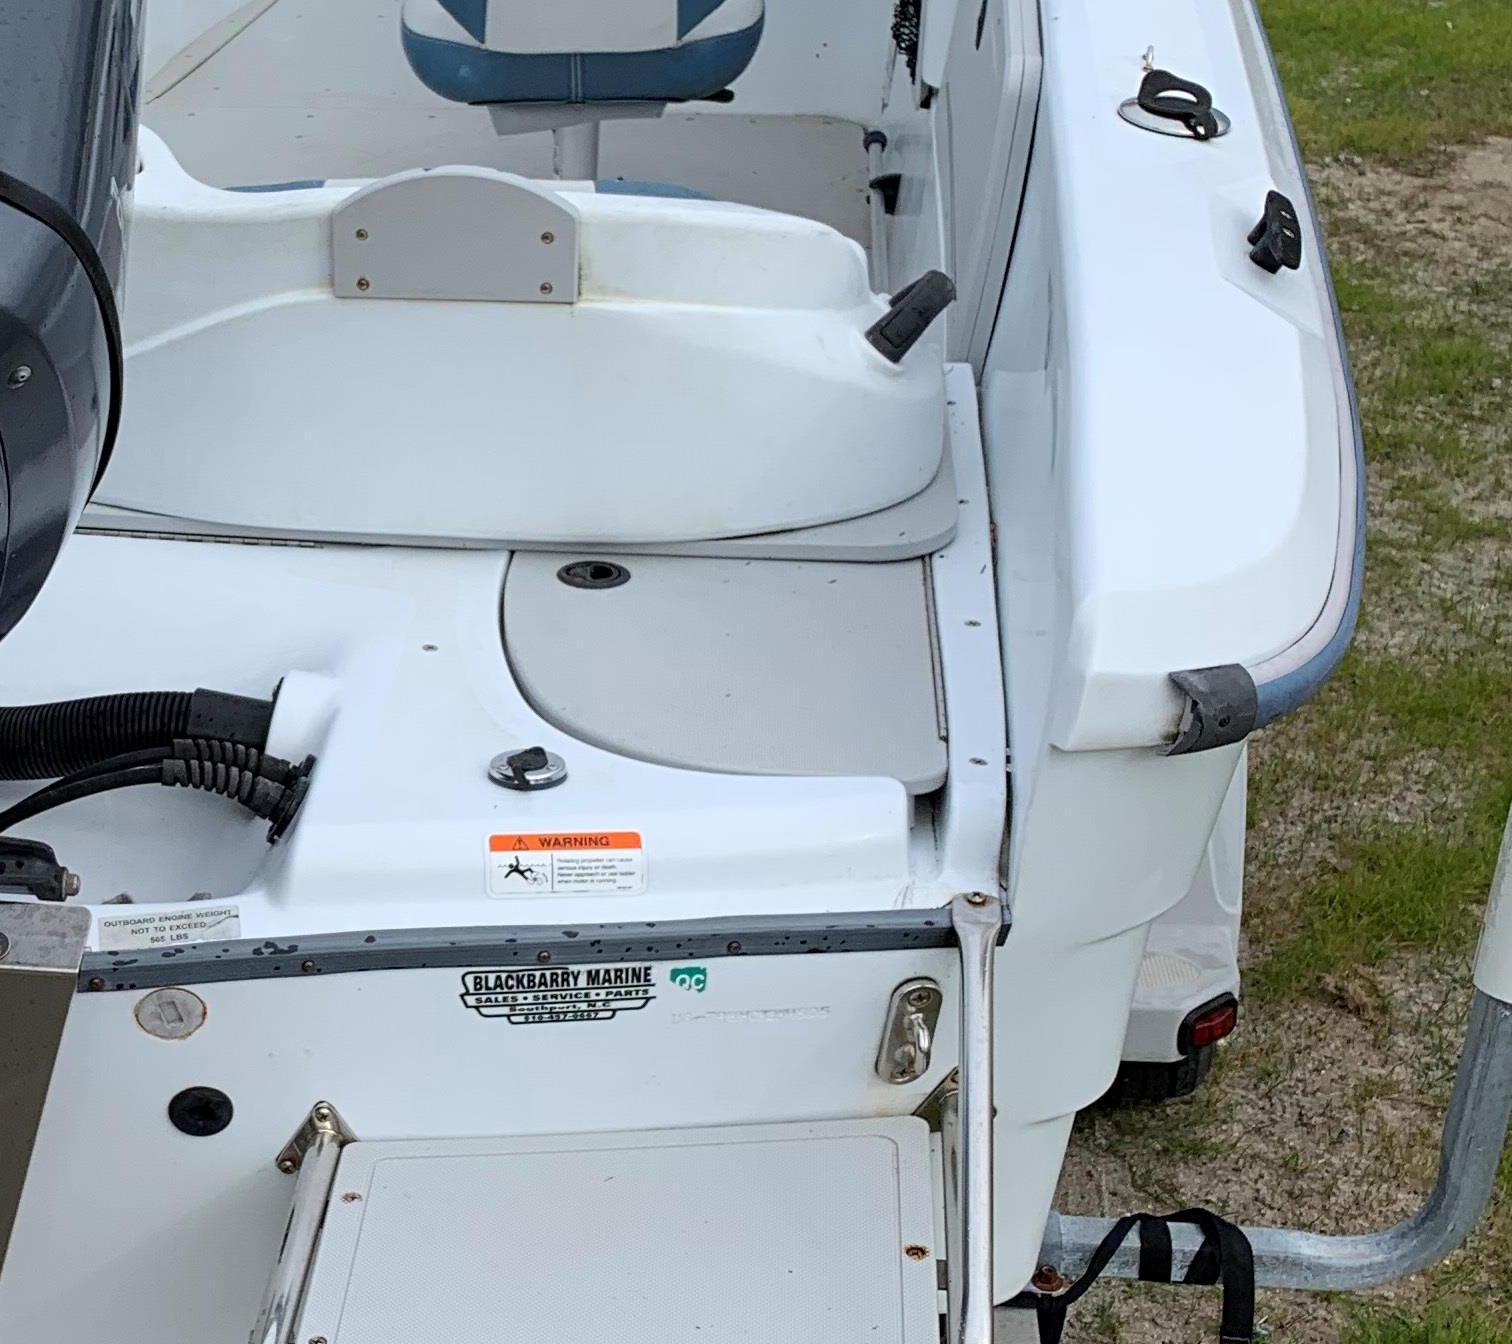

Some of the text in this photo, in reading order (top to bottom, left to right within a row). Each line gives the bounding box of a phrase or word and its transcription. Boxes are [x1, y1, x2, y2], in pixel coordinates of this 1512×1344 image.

[539, 836, 610, 848] WARNING
[103, 909, 230, 928] OUTBOARD ENGINE WEIGHT
[131, 921, 207, 935] NOT TO EXCEED
[171, 933, 189, 941] LBS
[473, 966, 652, 992] BLACKBARRY MARINE
[474, 989, 649, 1005] SALES SERVICE PARTS
